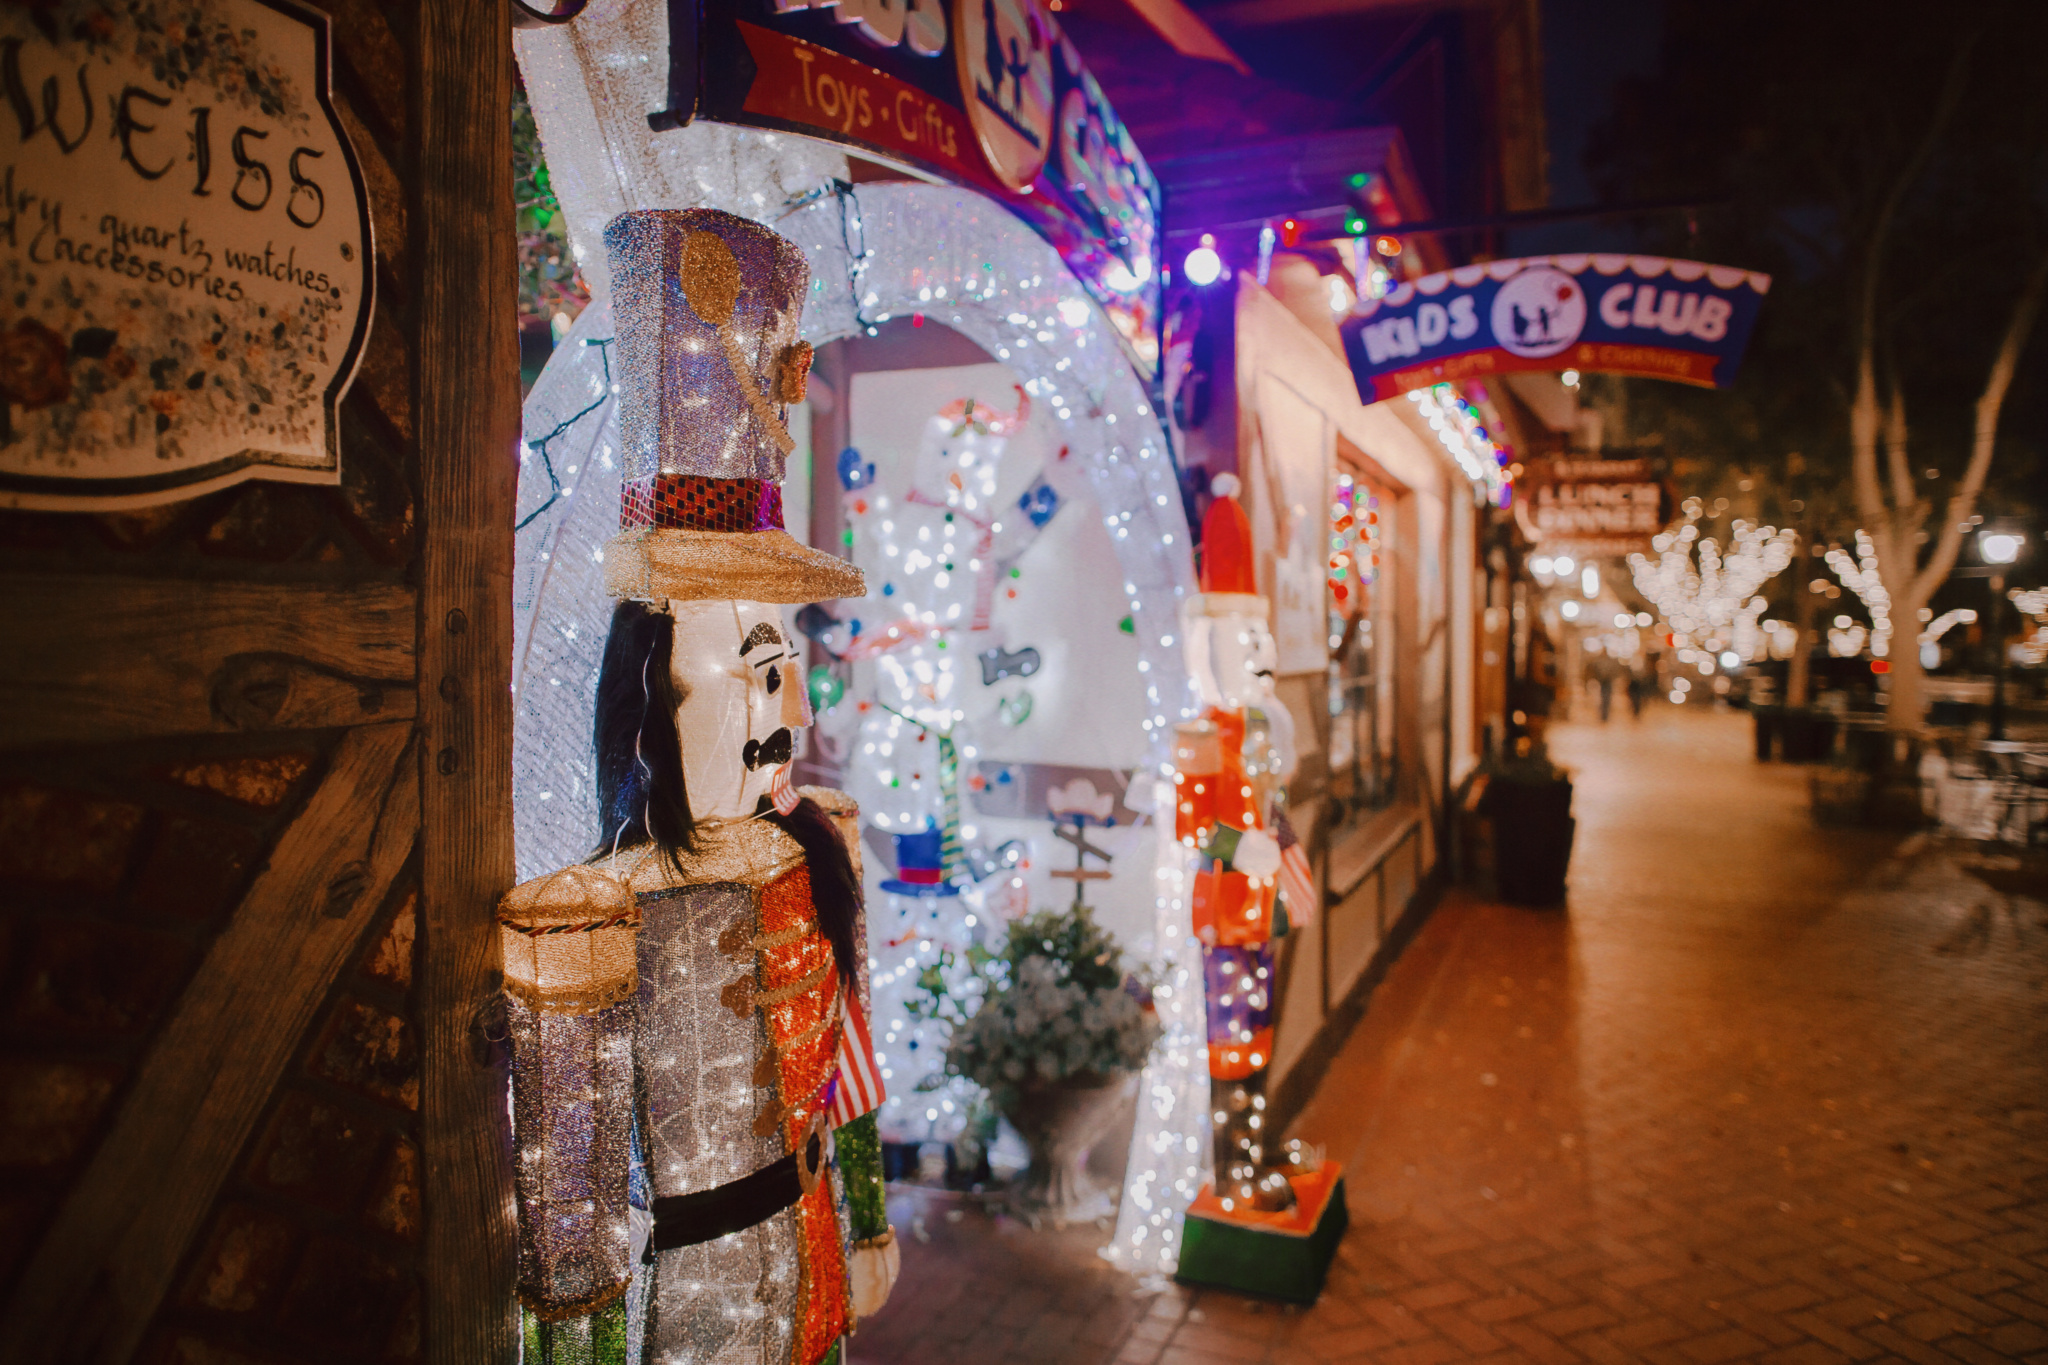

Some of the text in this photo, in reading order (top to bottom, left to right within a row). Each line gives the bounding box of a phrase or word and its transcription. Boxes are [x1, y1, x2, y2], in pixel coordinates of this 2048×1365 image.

[793, 47, 958, 158] Toys Gifts
[99, 213, 213, 272] quartz
[1360, 282, 1733, 365] KIDS CLUB
